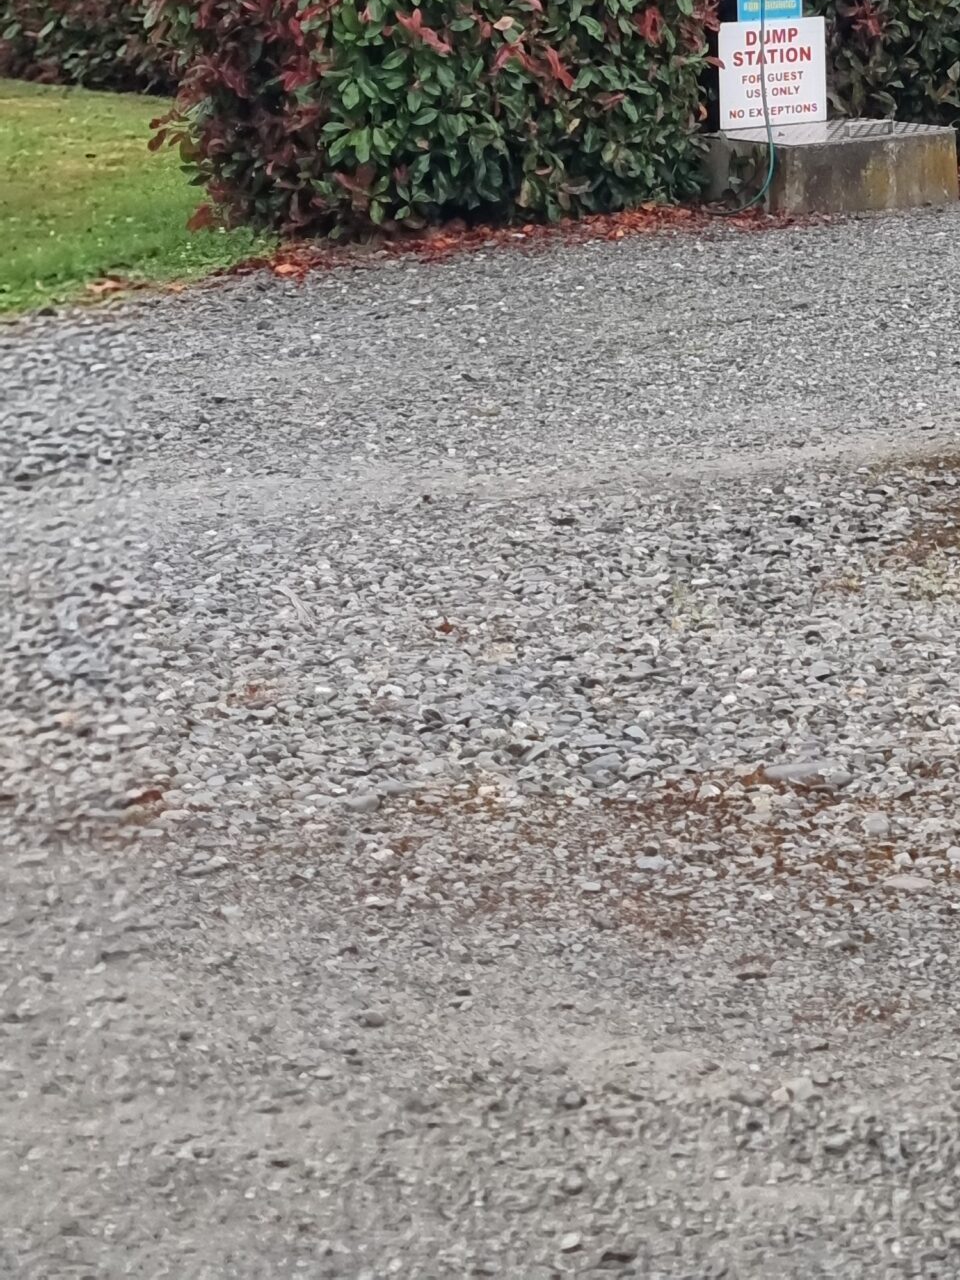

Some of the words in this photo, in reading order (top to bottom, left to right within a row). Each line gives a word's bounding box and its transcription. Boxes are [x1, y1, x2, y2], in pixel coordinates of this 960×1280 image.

[745, 27, 798, 46] DUMP
[733, 46, 812, 67] STATION
[741, 74, 764, 85] FOR
[767, 70, 804, 83] GUEST
[771, 85, 801, 97] ONLY
[729, 109, 745, 119] NO
